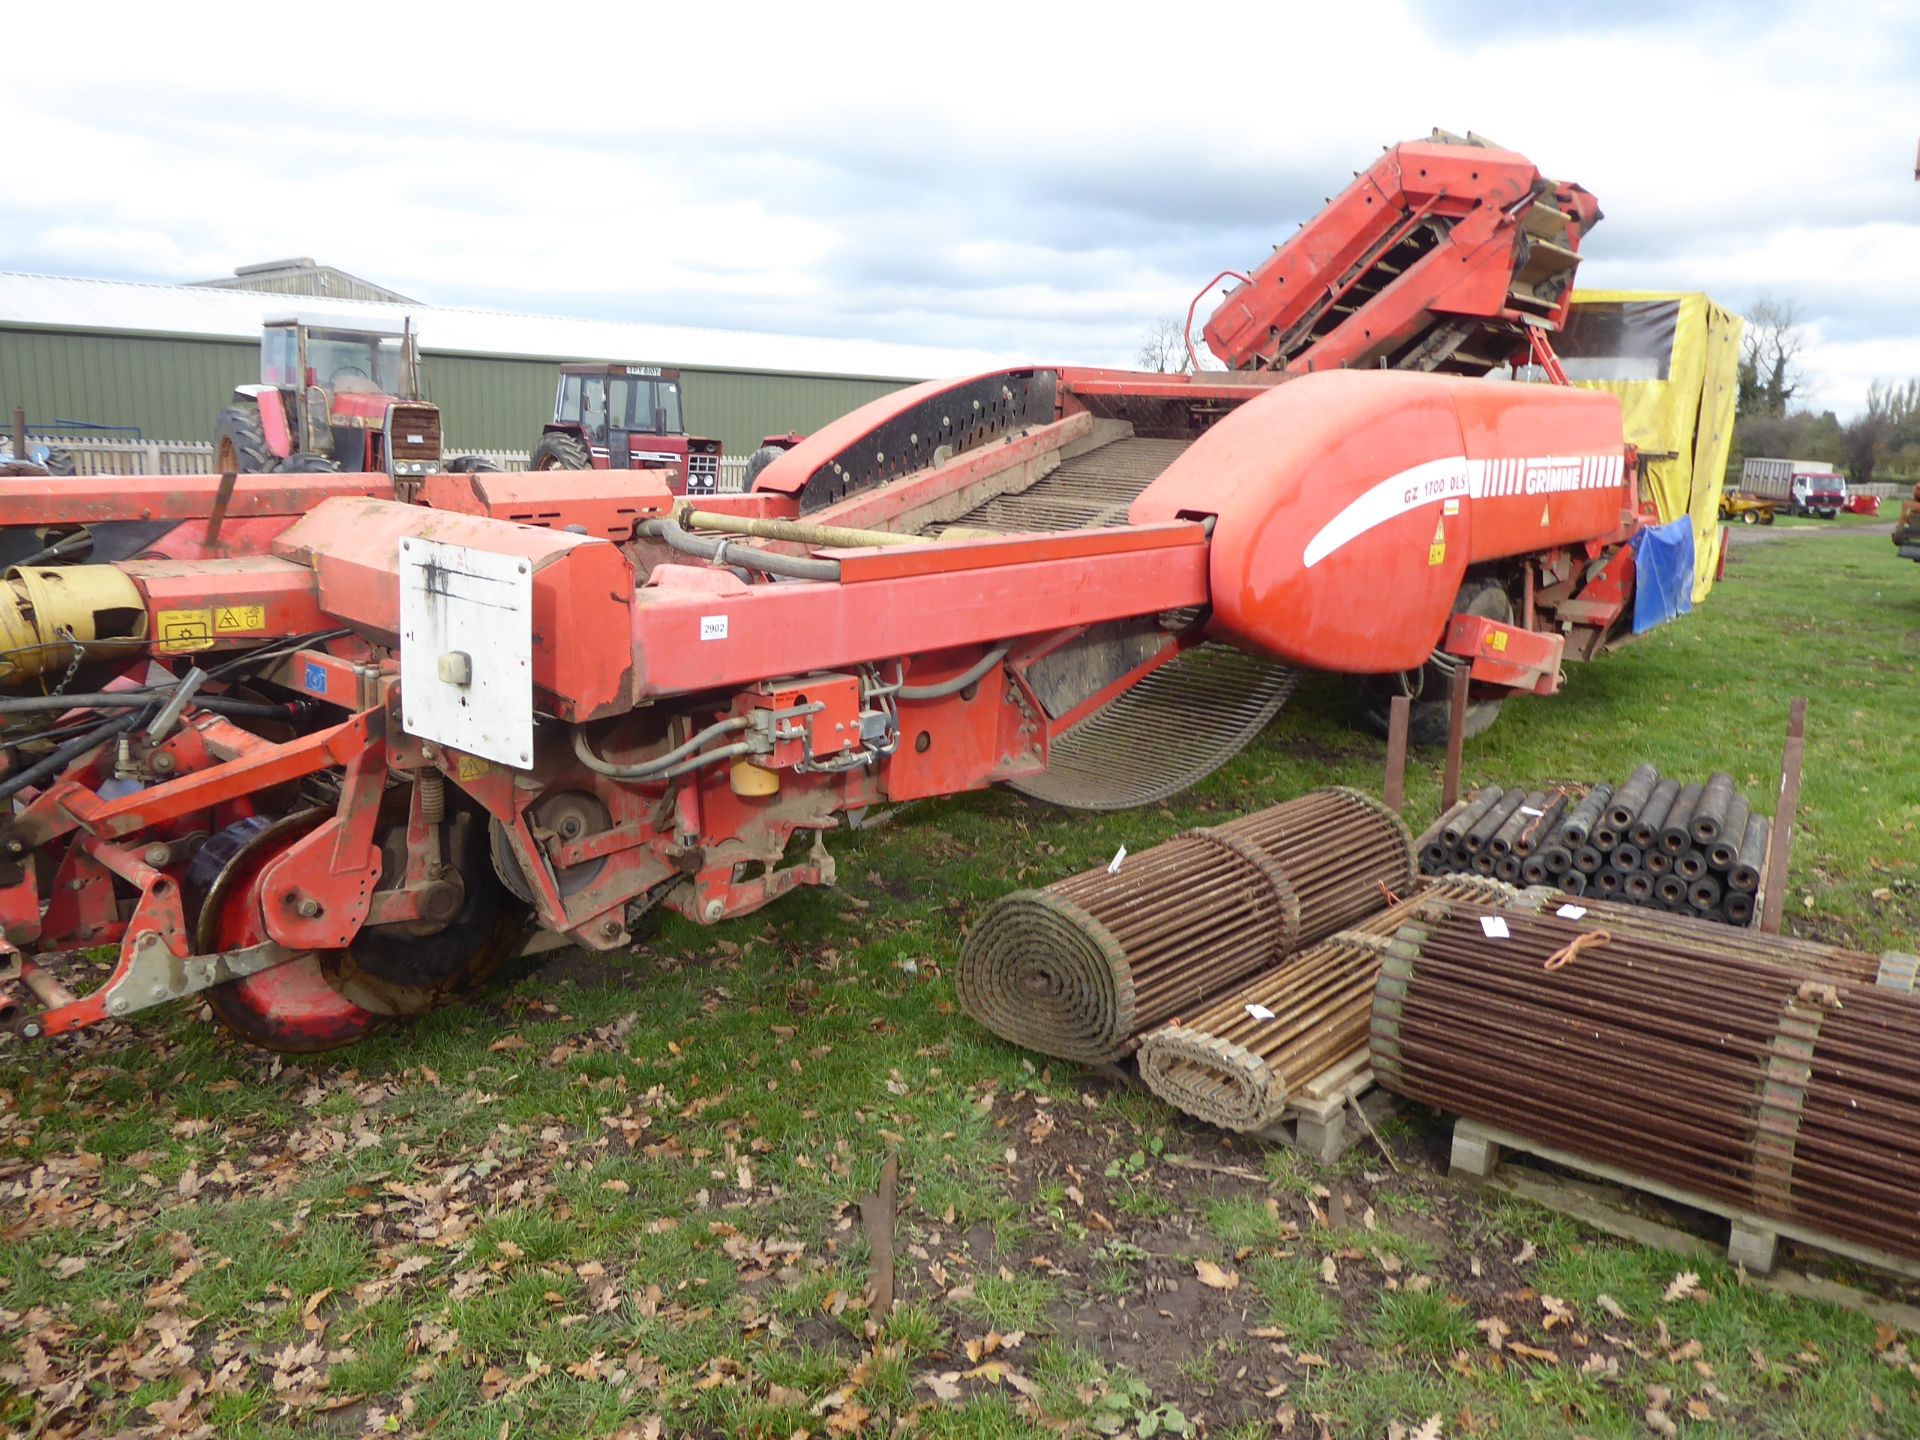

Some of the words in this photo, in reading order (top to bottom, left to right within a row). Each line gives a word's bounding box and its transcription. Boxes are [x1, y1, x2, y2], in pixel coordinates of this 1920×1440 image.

[1404, 486, 1418, 503] GZ
[1424, 478, 1445, 496] 1700
[1450, 474, 1466, 490] DLS
[1526, 468, 1580, 495] GRIMME
[704, 623, 725, 634] 2902
